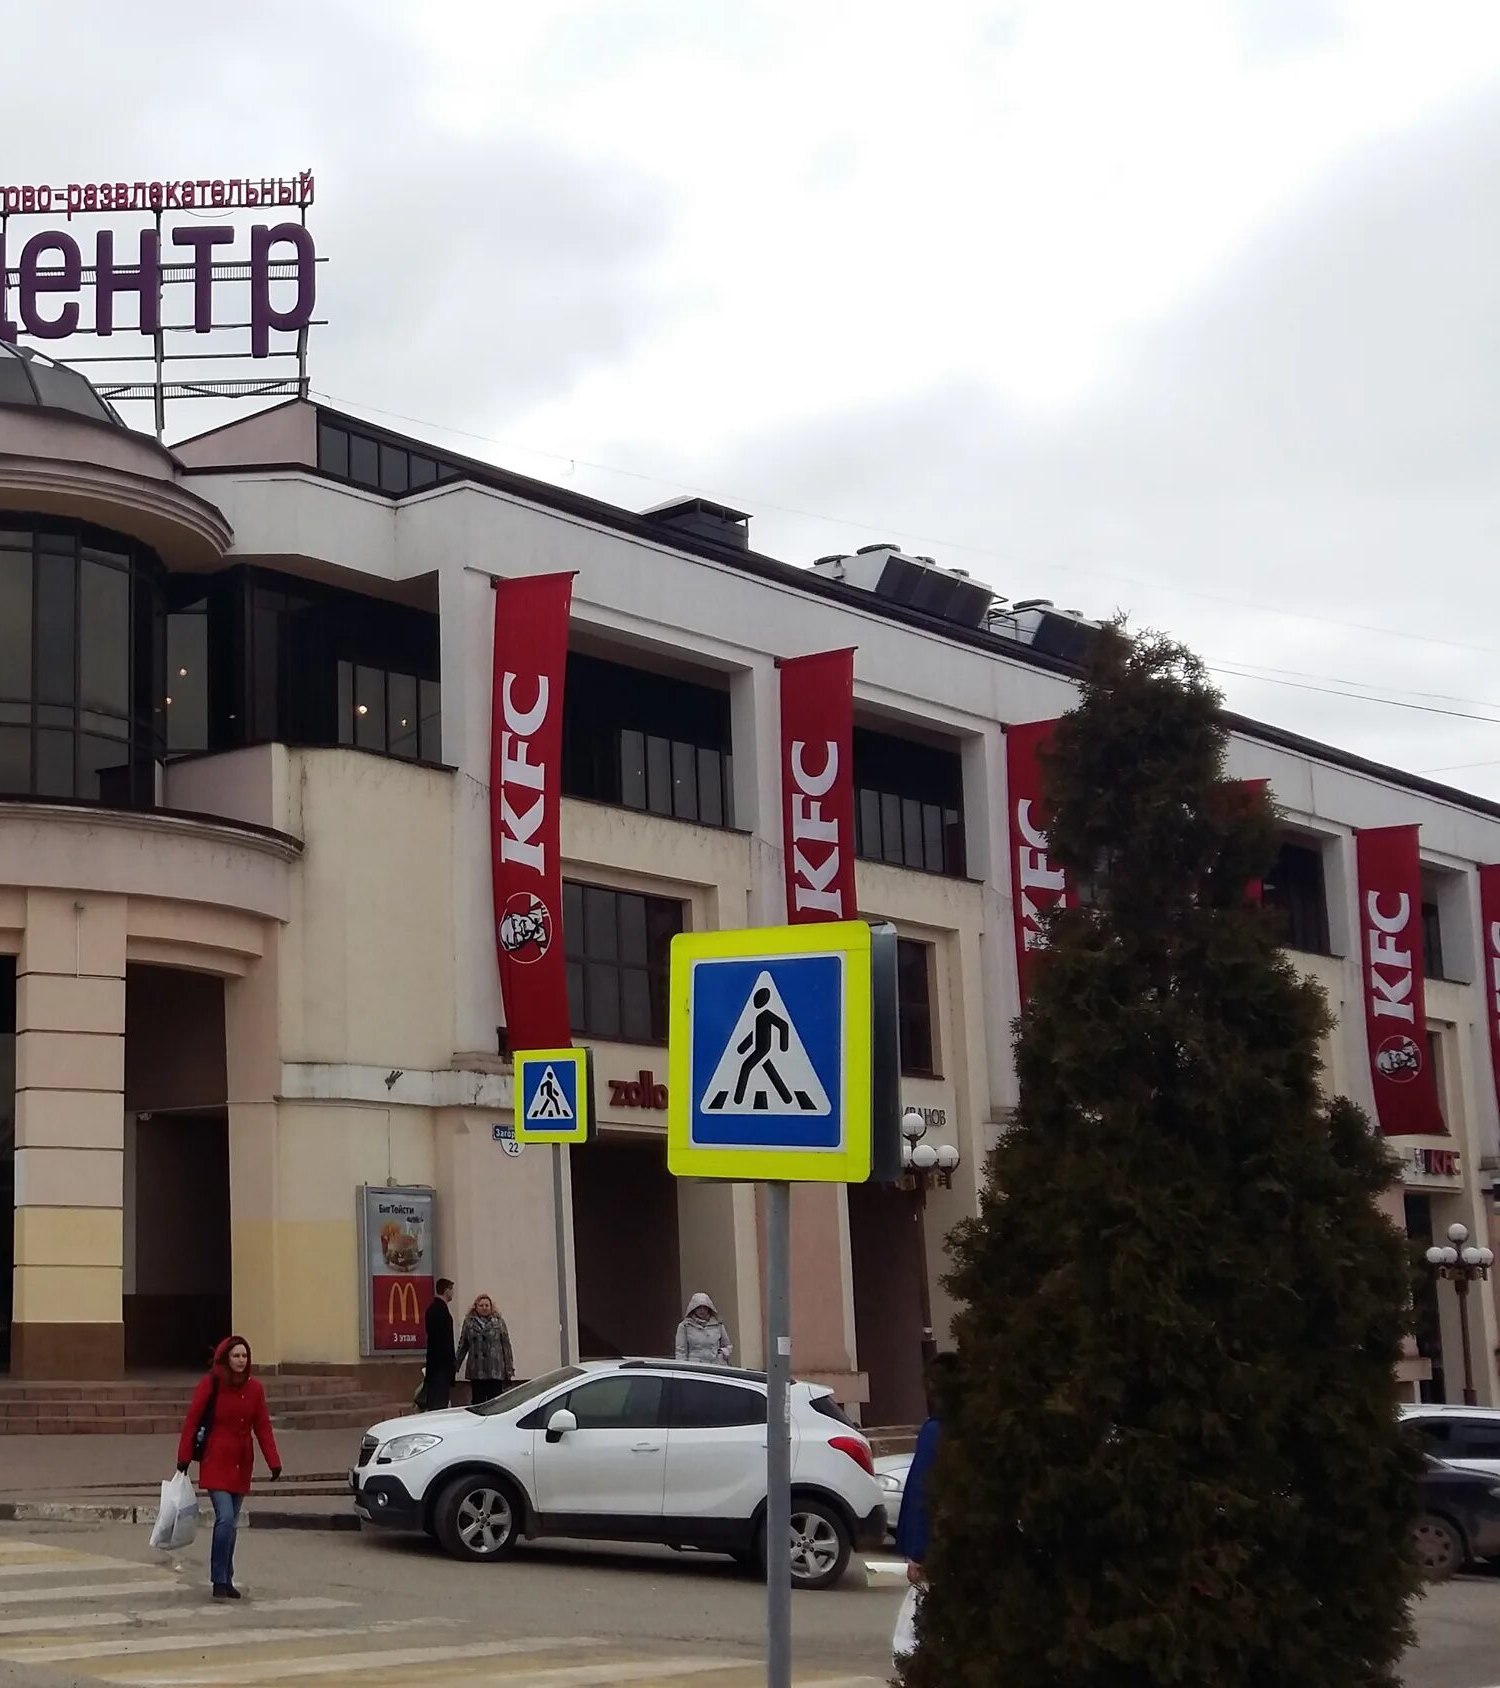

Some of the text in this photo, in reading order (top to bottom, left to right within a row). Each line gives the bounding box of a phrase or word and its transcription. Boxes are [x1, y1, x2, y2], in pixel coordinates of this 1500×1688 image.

[500, 671, 549, 876] KFC
[791, 740, 843, 918] KFC
[1367, 890, 1414, 1024] KFC
[509, 1142, 519, 1153] 22
[1431, 1149, 1461, 1176] KFC
